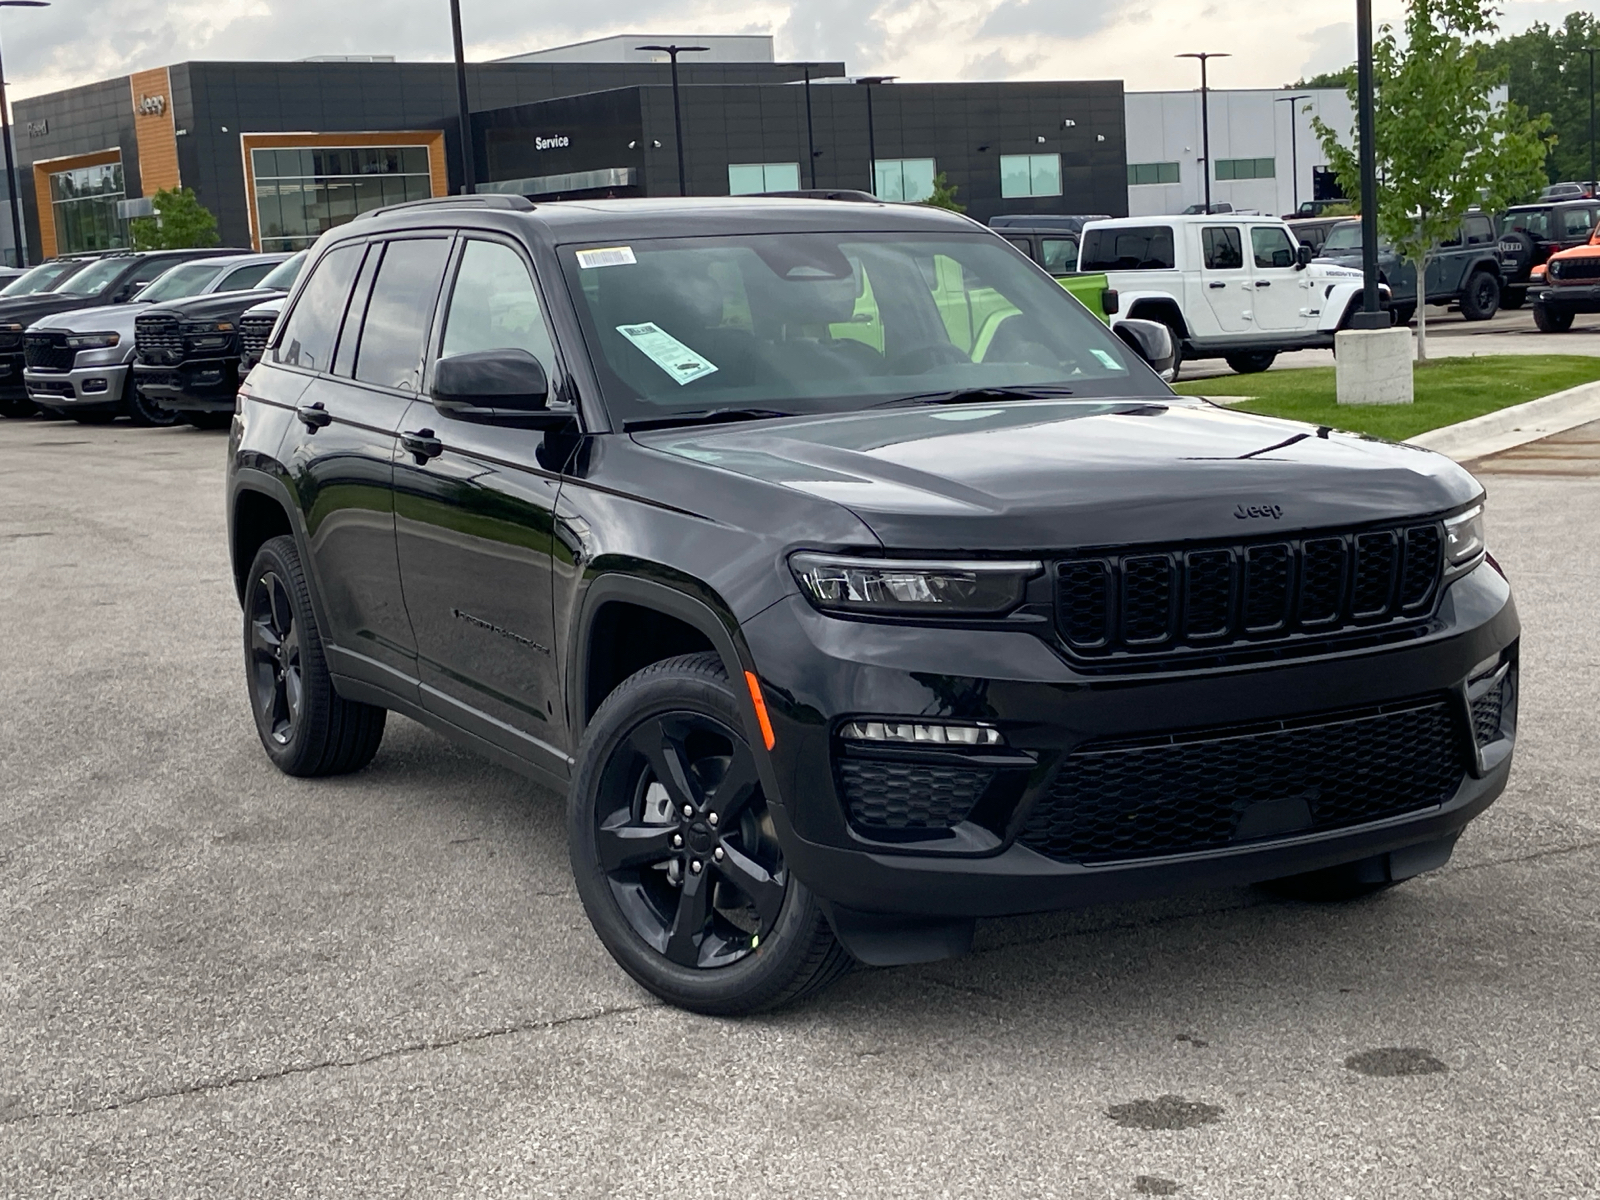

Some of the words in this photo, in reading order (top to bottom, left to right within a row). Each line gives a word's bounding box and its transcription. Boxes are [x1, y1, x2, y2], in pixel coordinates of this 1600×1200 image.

[138, 93, 165, 116] Jeep
[535, 134, 569, 151] Service
[1233, 504, 1283, 520] Jeep
